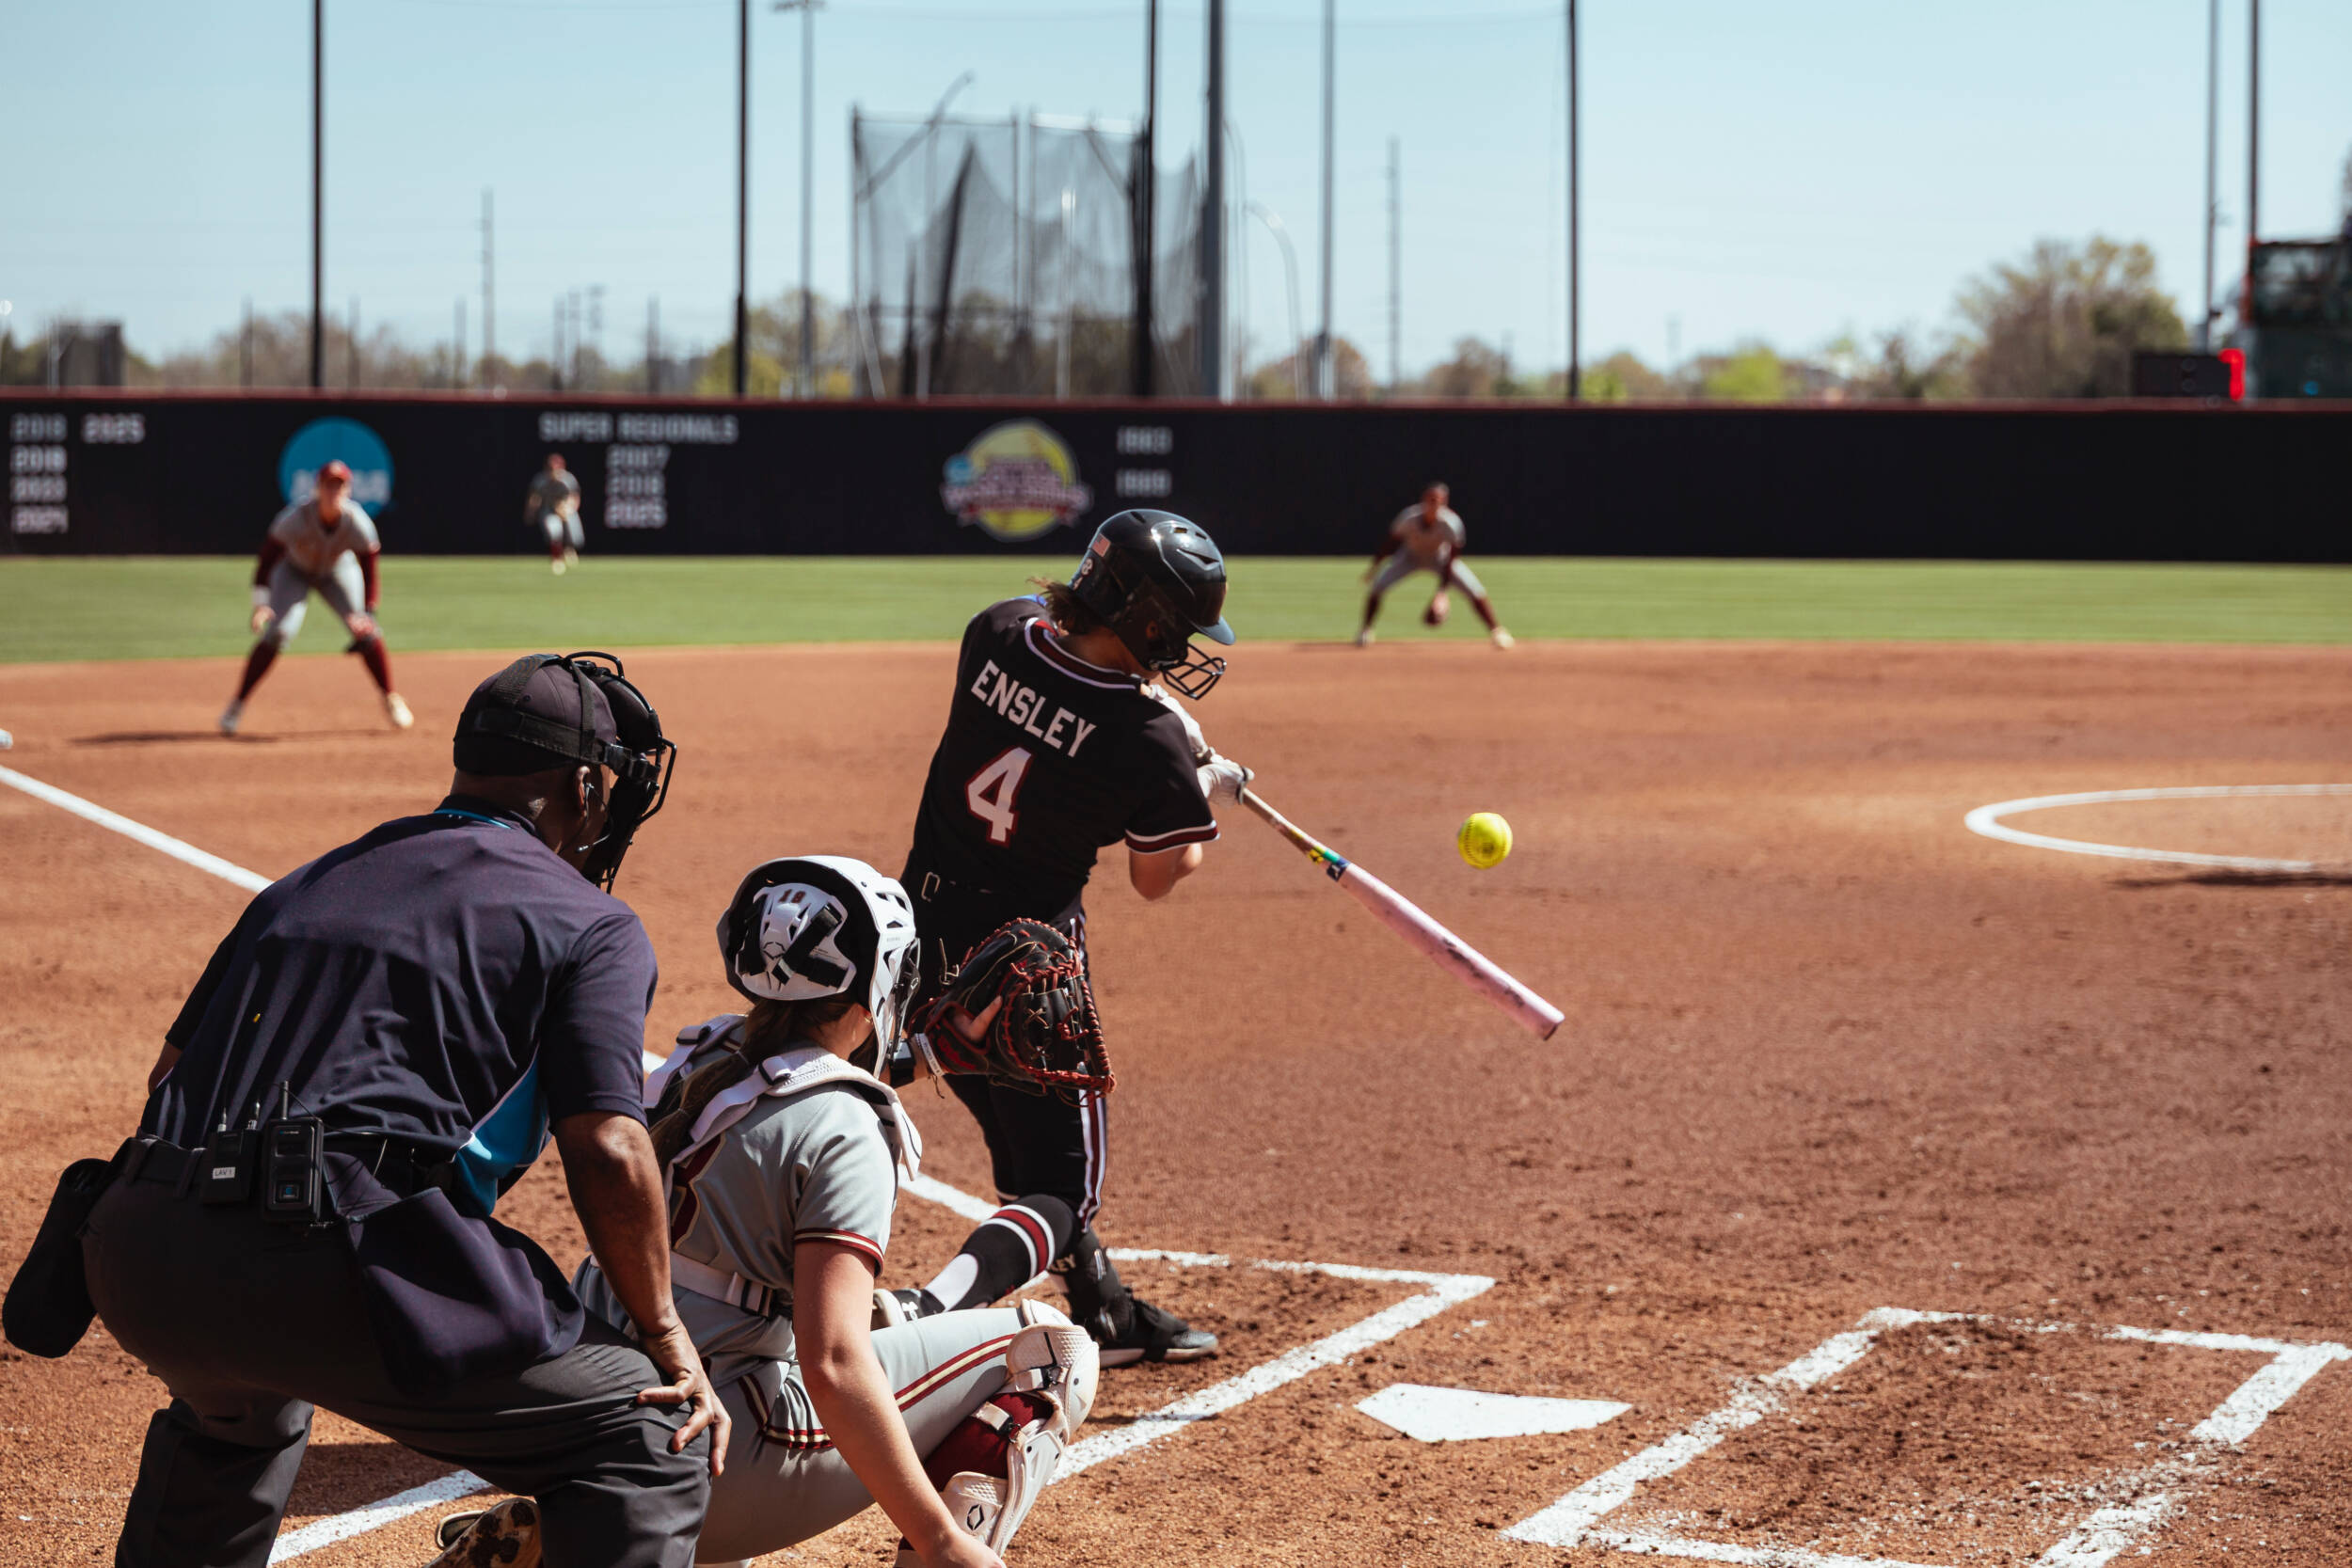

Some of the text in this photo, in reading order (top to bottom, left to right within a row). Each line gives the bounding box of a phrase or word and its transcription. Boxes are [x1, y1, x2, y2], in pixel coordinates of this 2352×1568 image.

[540, 414, 738, 442] SUPER REGIONALS
[971, 659, 1097, 757] ENSLEY
[965, 746, 1033, 847] 4
[778, 889, 806, 903] 18
